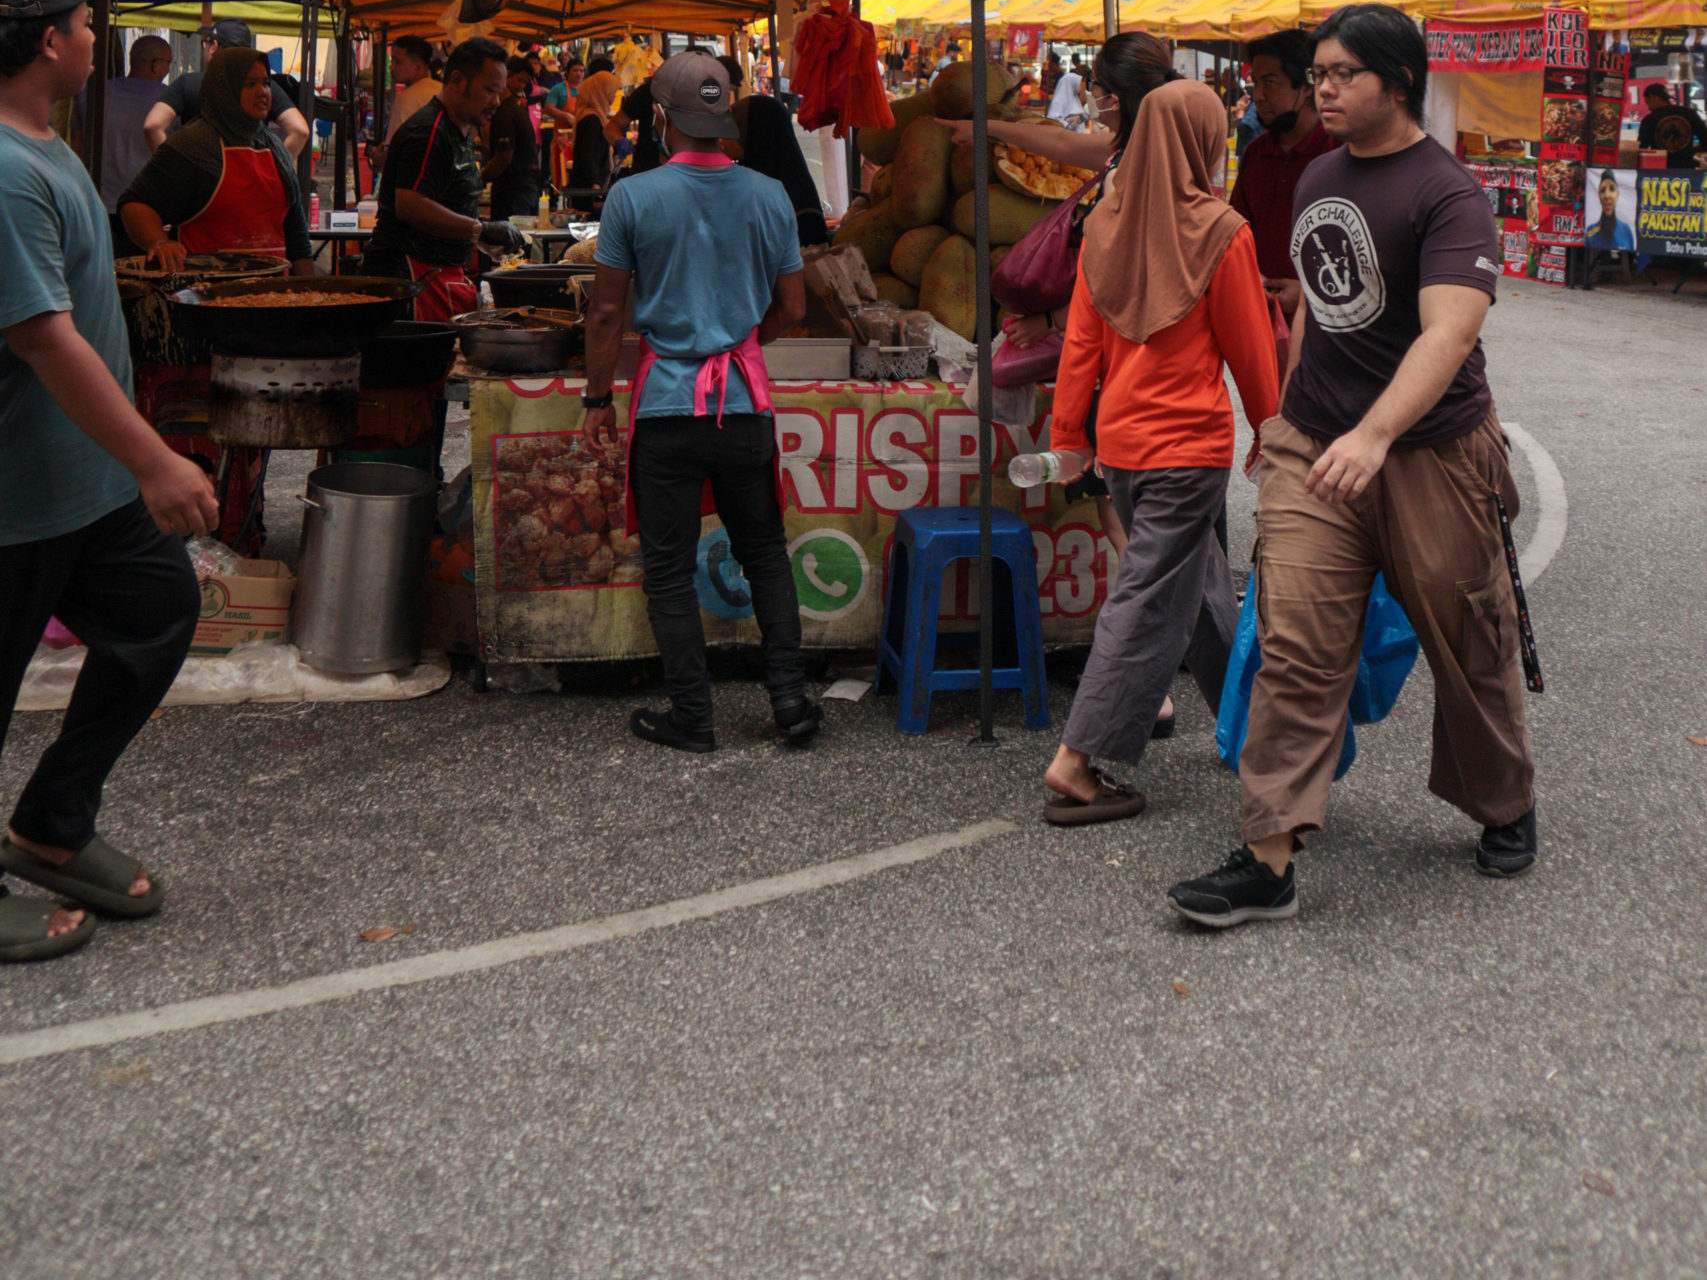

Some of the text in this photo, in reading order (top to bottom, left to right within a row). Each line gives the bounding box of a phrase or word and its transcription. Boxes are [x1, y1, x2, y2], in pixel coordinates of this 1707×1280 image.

[1641, 177, 1690, 210] NASI
[1639, 211, 1703, 236] PAKISTAN
[1291, 206, 1373, 277] VIPER CHALLENGE
[1665, 240, 1685, 254] Batu
[774, 407, 1053, 516] RISPY
